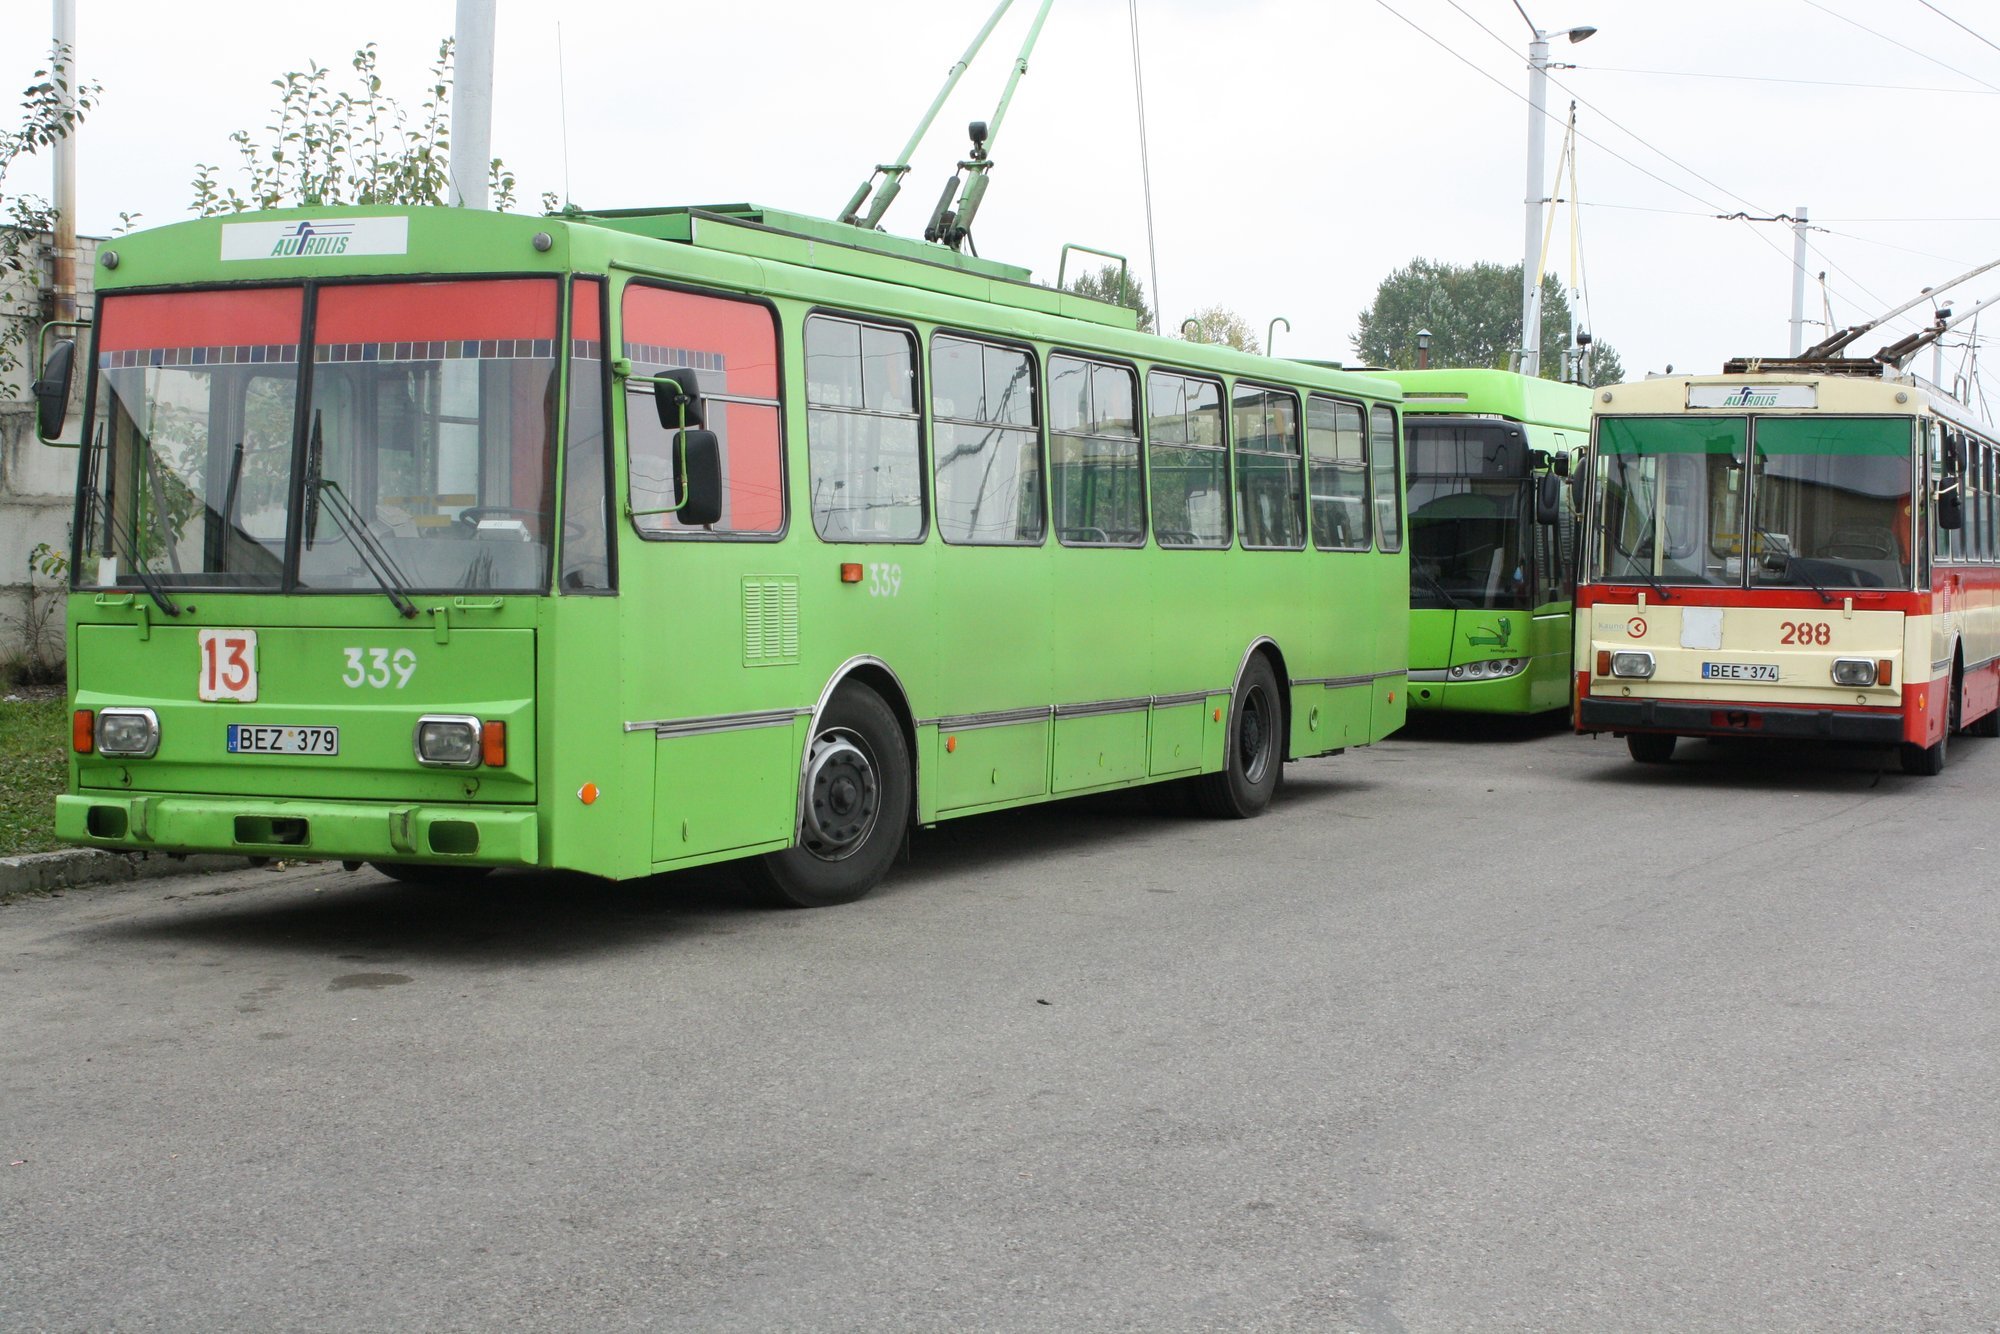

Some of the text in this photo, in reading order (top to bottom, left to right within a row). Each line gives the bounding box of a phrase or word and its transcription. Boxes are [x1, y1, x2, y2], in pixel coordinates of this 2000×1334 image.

[271, 228, 349, 257] AUTROLIS
[1723, 391, 1777, 406] AUTROLIS
[869, 562, 902, 597] 339
[1780, 621, 1831, 646] 288
[204, 637, 250, 691] 13
[342, 647, 417, 689] 339
[1710, 664, 1776, 680] BEE 374
[240, 728, 334, 752] BEZ 379
